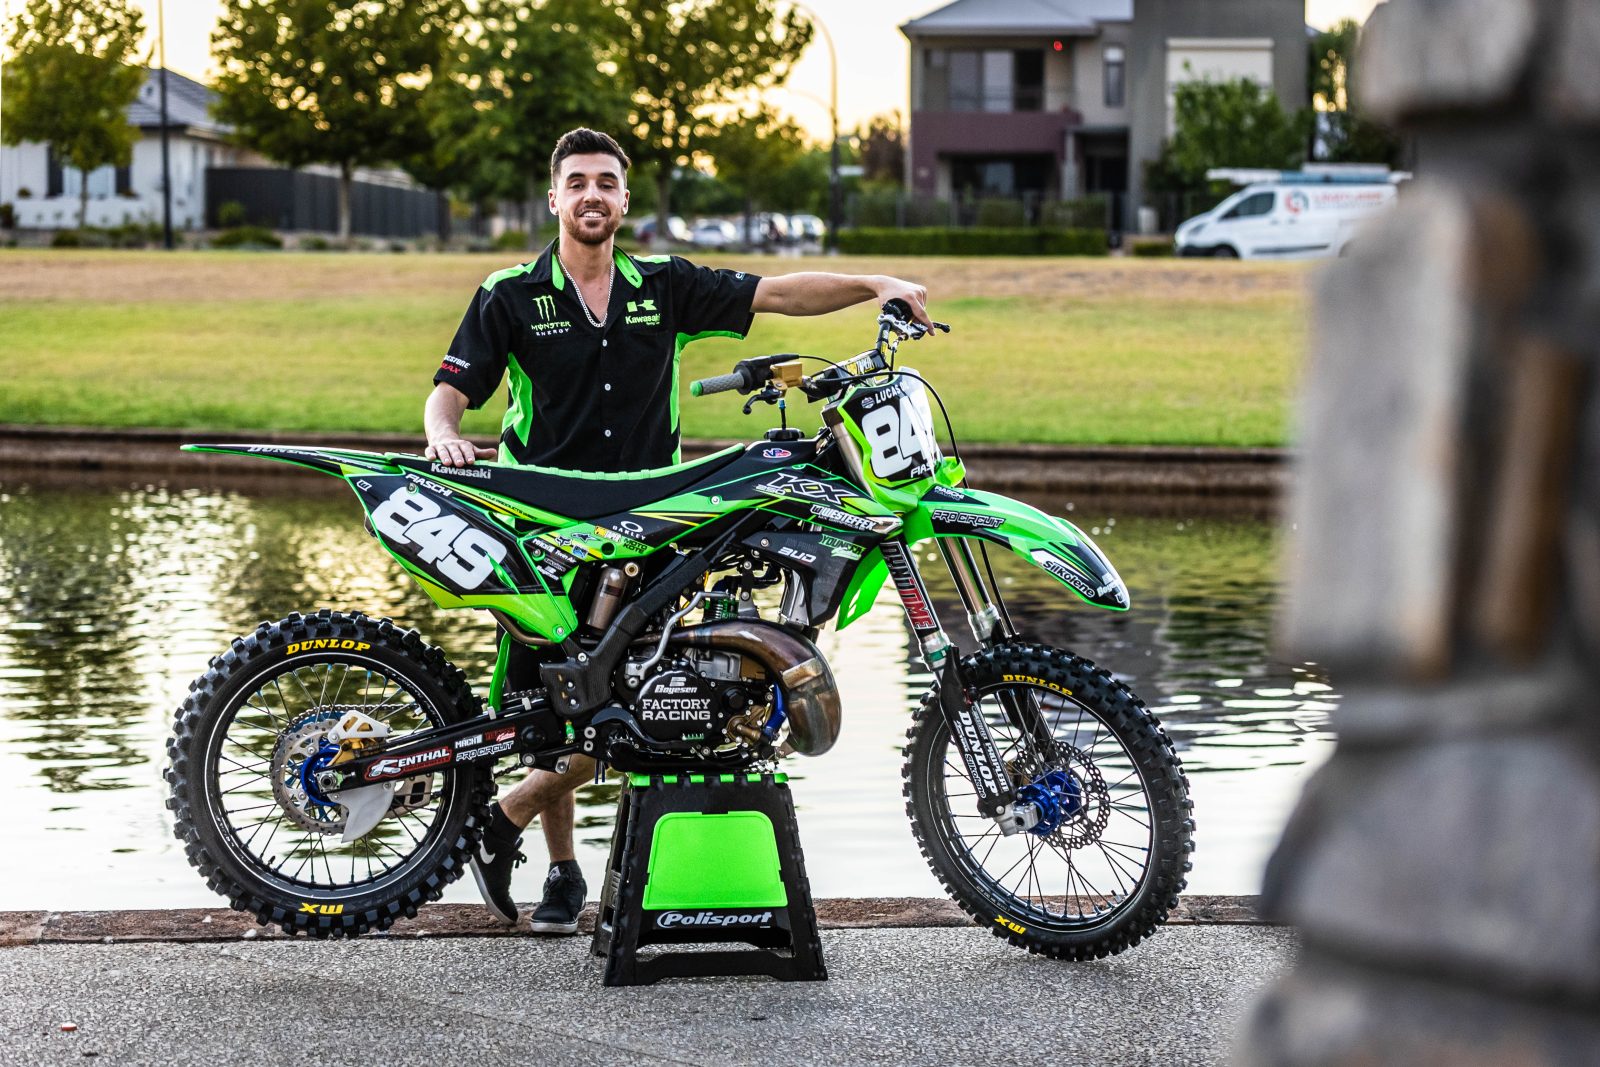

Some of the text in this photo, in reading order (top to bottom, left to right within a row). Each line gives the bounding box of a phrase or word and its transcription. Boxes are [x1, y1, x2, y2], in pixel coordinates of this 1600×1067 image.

[531, 321, 571, 331] MONSTER
[625, 314, 661, 325] Kawasaki
[536, 328, 569, 336] ENERGY
[874, 385, 901, 404] LUCAS
[431, 463, 491, 480] Kawasaki
[405, 473, 453, 497] FIASCHI
[932, 510, 1004, 528] PRO CIRCUIT
[612, 525, 646, 541] OAKLEY
[624, 538, 648, 550] MOTO
[1043, 560, 1096, 598] Silkolene
[286, 638, 370, 655] DUNLOP
[655, 685, 698, 695] Boyesen
[1003, 674, 1073, 697] DUNLOP
[642, 698, 711, 710] FACTORY
[642, 710, 711, 721] RACING
[456, 740, 515, 762] PRO CIRCUIT
[958, 711, 998, 797] DUNLOP
[656, 910, 773, 929] Polisport
